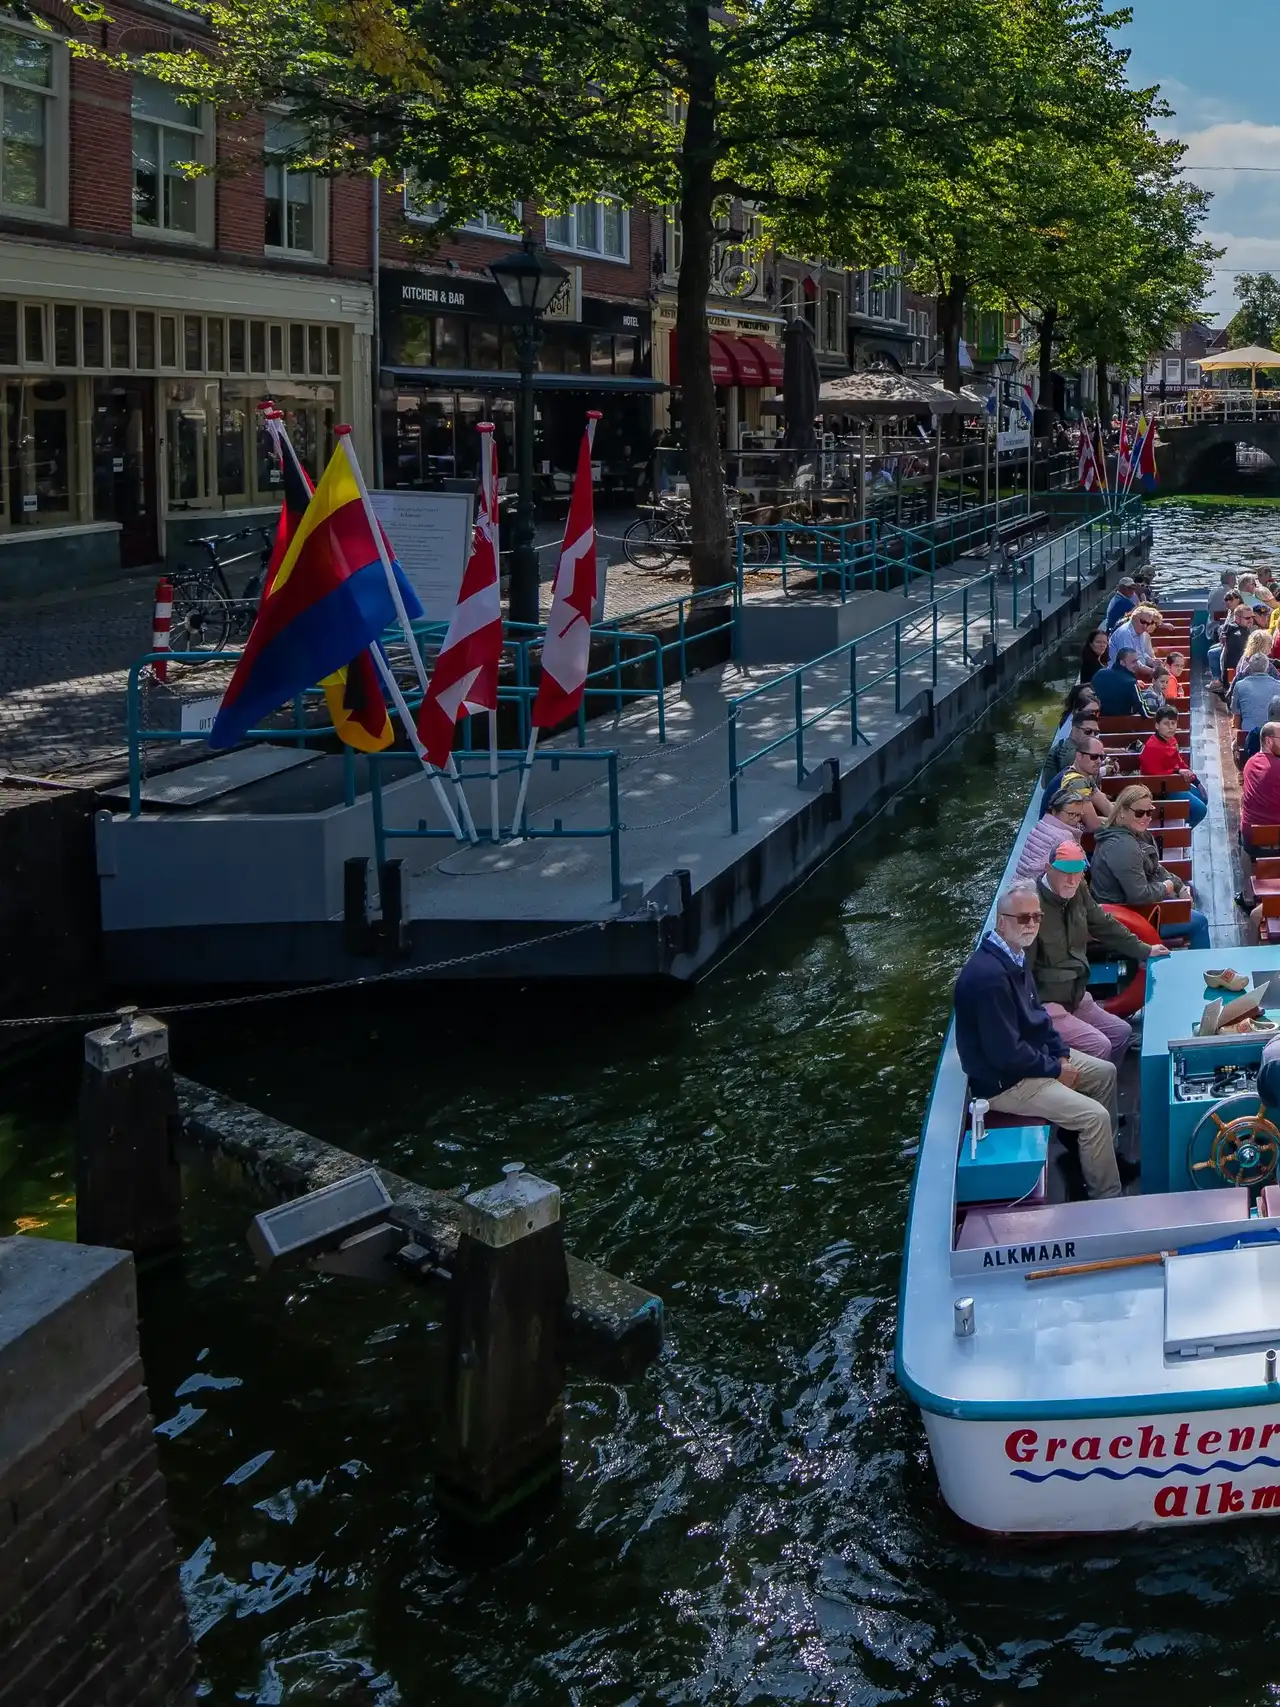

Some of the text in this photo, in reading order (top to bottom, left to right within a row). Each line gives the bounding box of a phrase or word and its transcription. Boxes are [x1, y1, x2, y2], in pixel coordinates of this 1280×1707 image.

[402, 285, 465, 305] KITCHEN & BAR
[623, 315, 639, 327] HOTEL
[983, 1242, 1076, 1268] ALKMAAR
